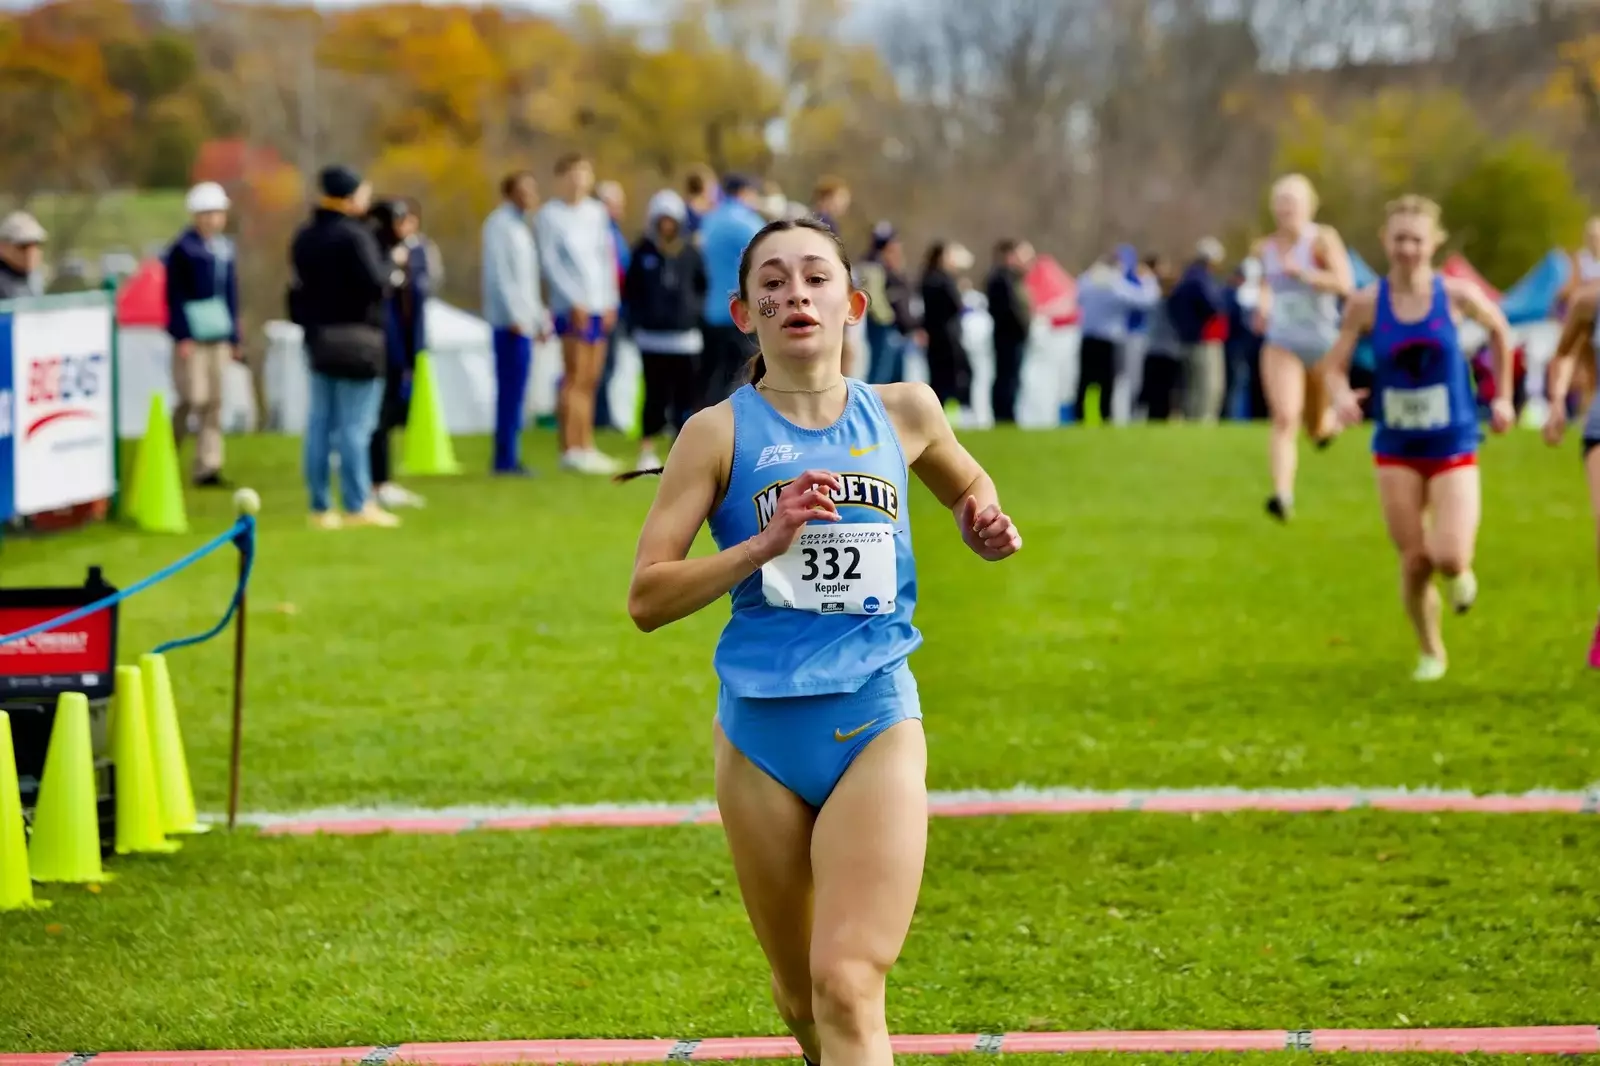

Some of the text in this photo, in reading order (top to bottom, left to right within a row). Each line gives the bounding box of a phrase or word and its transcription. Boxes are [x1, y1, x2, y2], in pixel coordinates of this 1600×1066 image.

[760, 444, 793, 454] BIG
[756, 453, 802, 466] EAST
[755, 474, 897, 527] MUETTE
[800, 532, 835, 540] CROSS
[800, 538, 883, 546] CHAMPIONSHIPS
[801, 546, 862, 581] 332
[815, 582, 850, 594] Keppler
